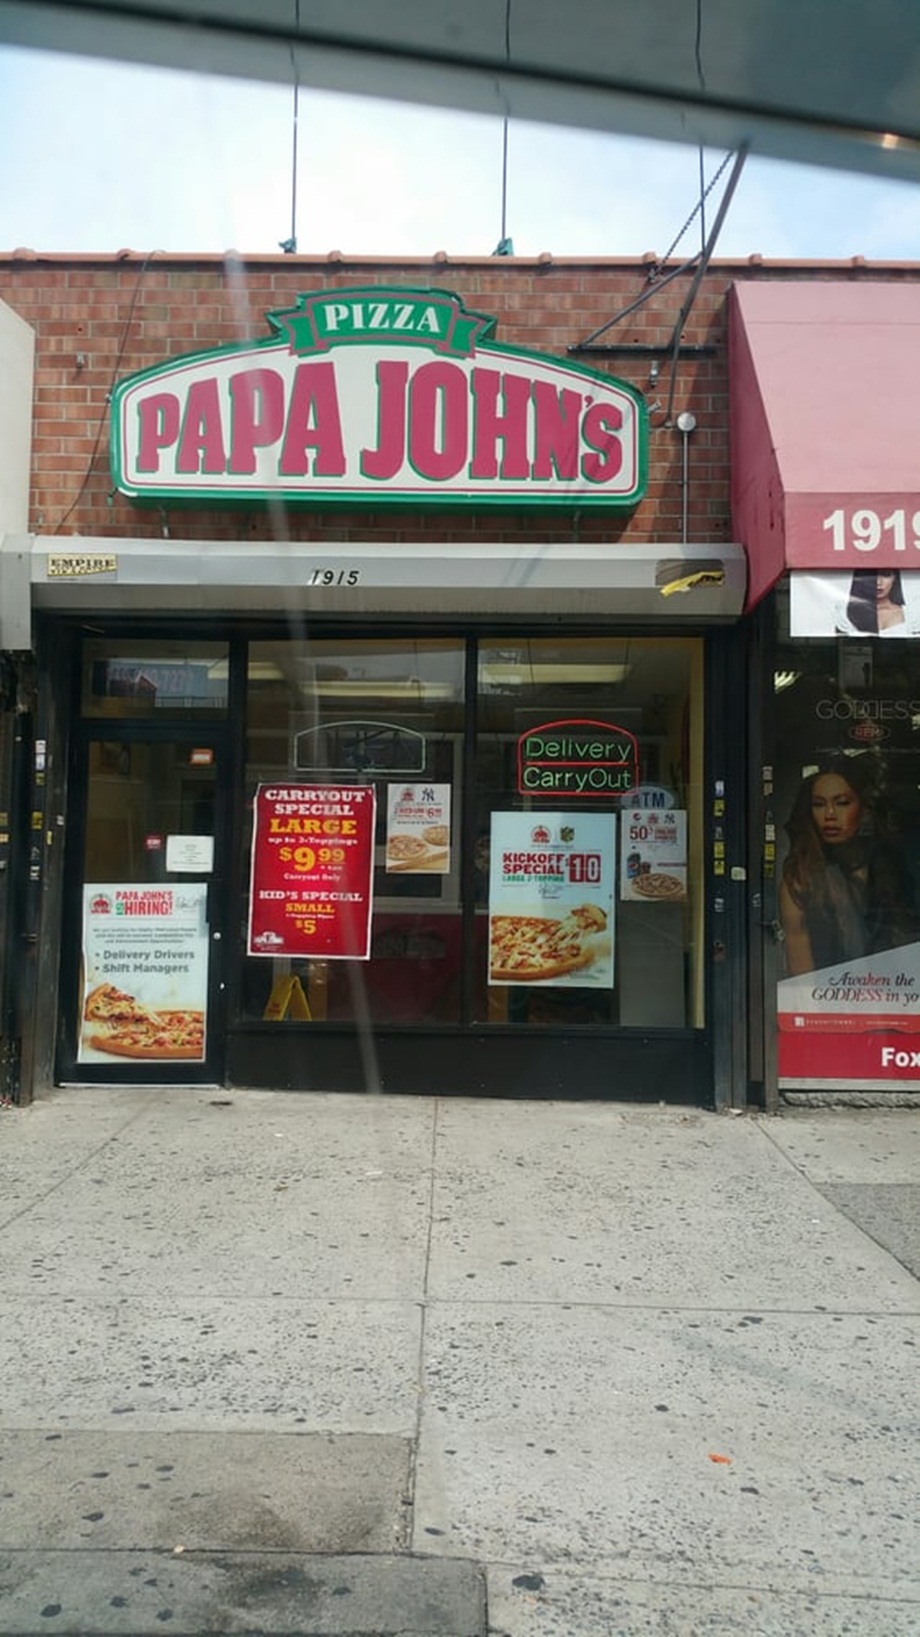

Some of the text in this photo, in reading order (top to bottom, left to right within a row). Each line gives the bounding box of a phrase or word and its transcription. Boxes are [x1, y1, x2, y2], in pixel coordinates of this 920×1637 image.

[324, 303, 441, 333] PIZZA
[135, 360, 623, 481] PAPA JOHN'S
[823, 509, 920, 551] 191
[51, 558, 116, 567] EMPIRE
[311, 570, 360, 586] 1915
[526, 737, 632, 763] Delivery
[523, 767, 632, 793] CarryOut
[265, 789, 365, 802] CARRYOUT
[631, 791, 665, 808] ATM
[275, 804, 354, 816] SPECIAL
[270, 819, 357, 835] LARGE
[502, 852, 565, 863] KICKOFF
[502, 863, 564, 875] SPECIAL
[116, 891, 139, 900] PAPA
[259, 890, 363, 902] KID'S SPECIAL
[125, 901, 173, 915] HIRING!
[285, 903, 335, 913] SMALL
[103, 950, 195, 961] Delivery Drivers
[103, 964, 189, 975] Shift Managers
[828, 972, 915, 986] Awaken the
[811, 987, 881, 1002] GODDESS
[886, 989, 899, 1001] in
